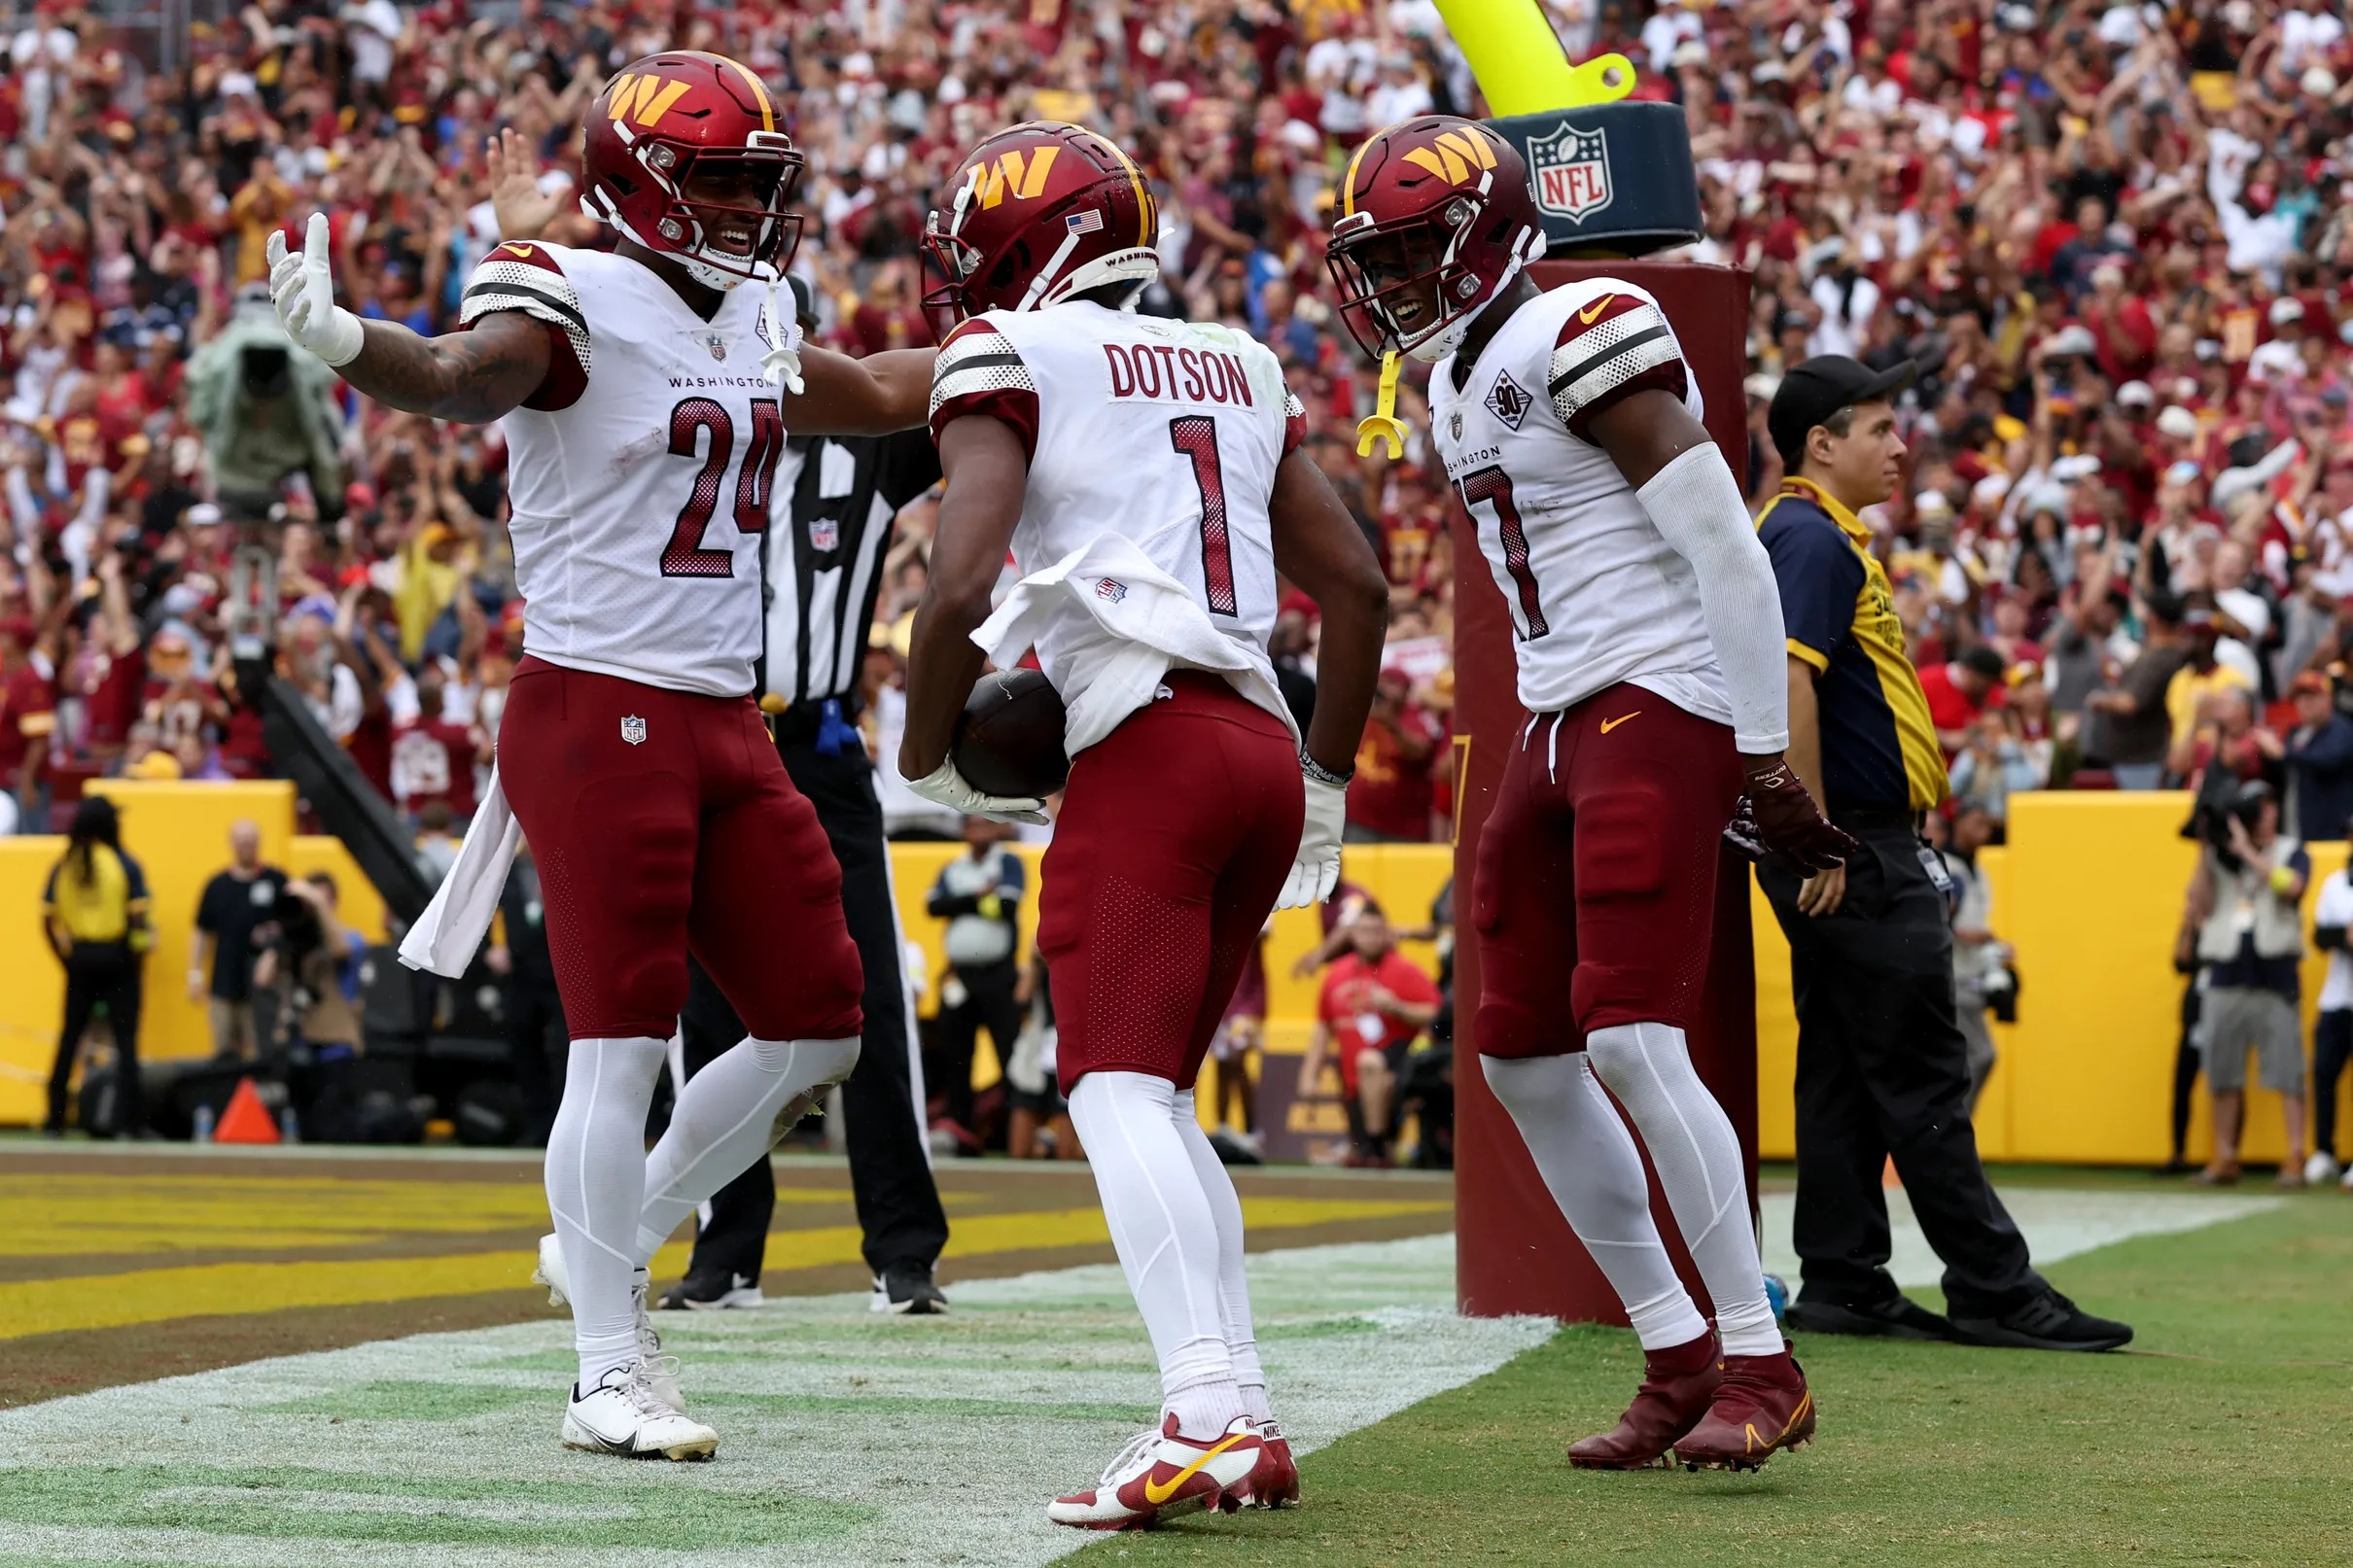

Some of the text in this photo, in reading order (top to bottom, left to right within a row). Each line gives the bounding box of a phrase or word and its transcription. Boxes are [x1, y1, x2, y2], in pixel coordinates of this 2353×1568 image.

[1542, 164, 1604, 208] NFL
[669, 377, 778, 388] WASHINGTON
[1103, 344, 1253, 407] DOTSON
[1495, 385, 1522, 416] 90
[1447, 445, 1500, 473] SHINGTON
[659, 397, 785, 578] 24
[1169, 414, 1238, 618] 1
[1098, 579, 1117, 597] NFL
[626, 728, 643, 739] NFL
[1263, 1424, 1282, 1439] NIKE
